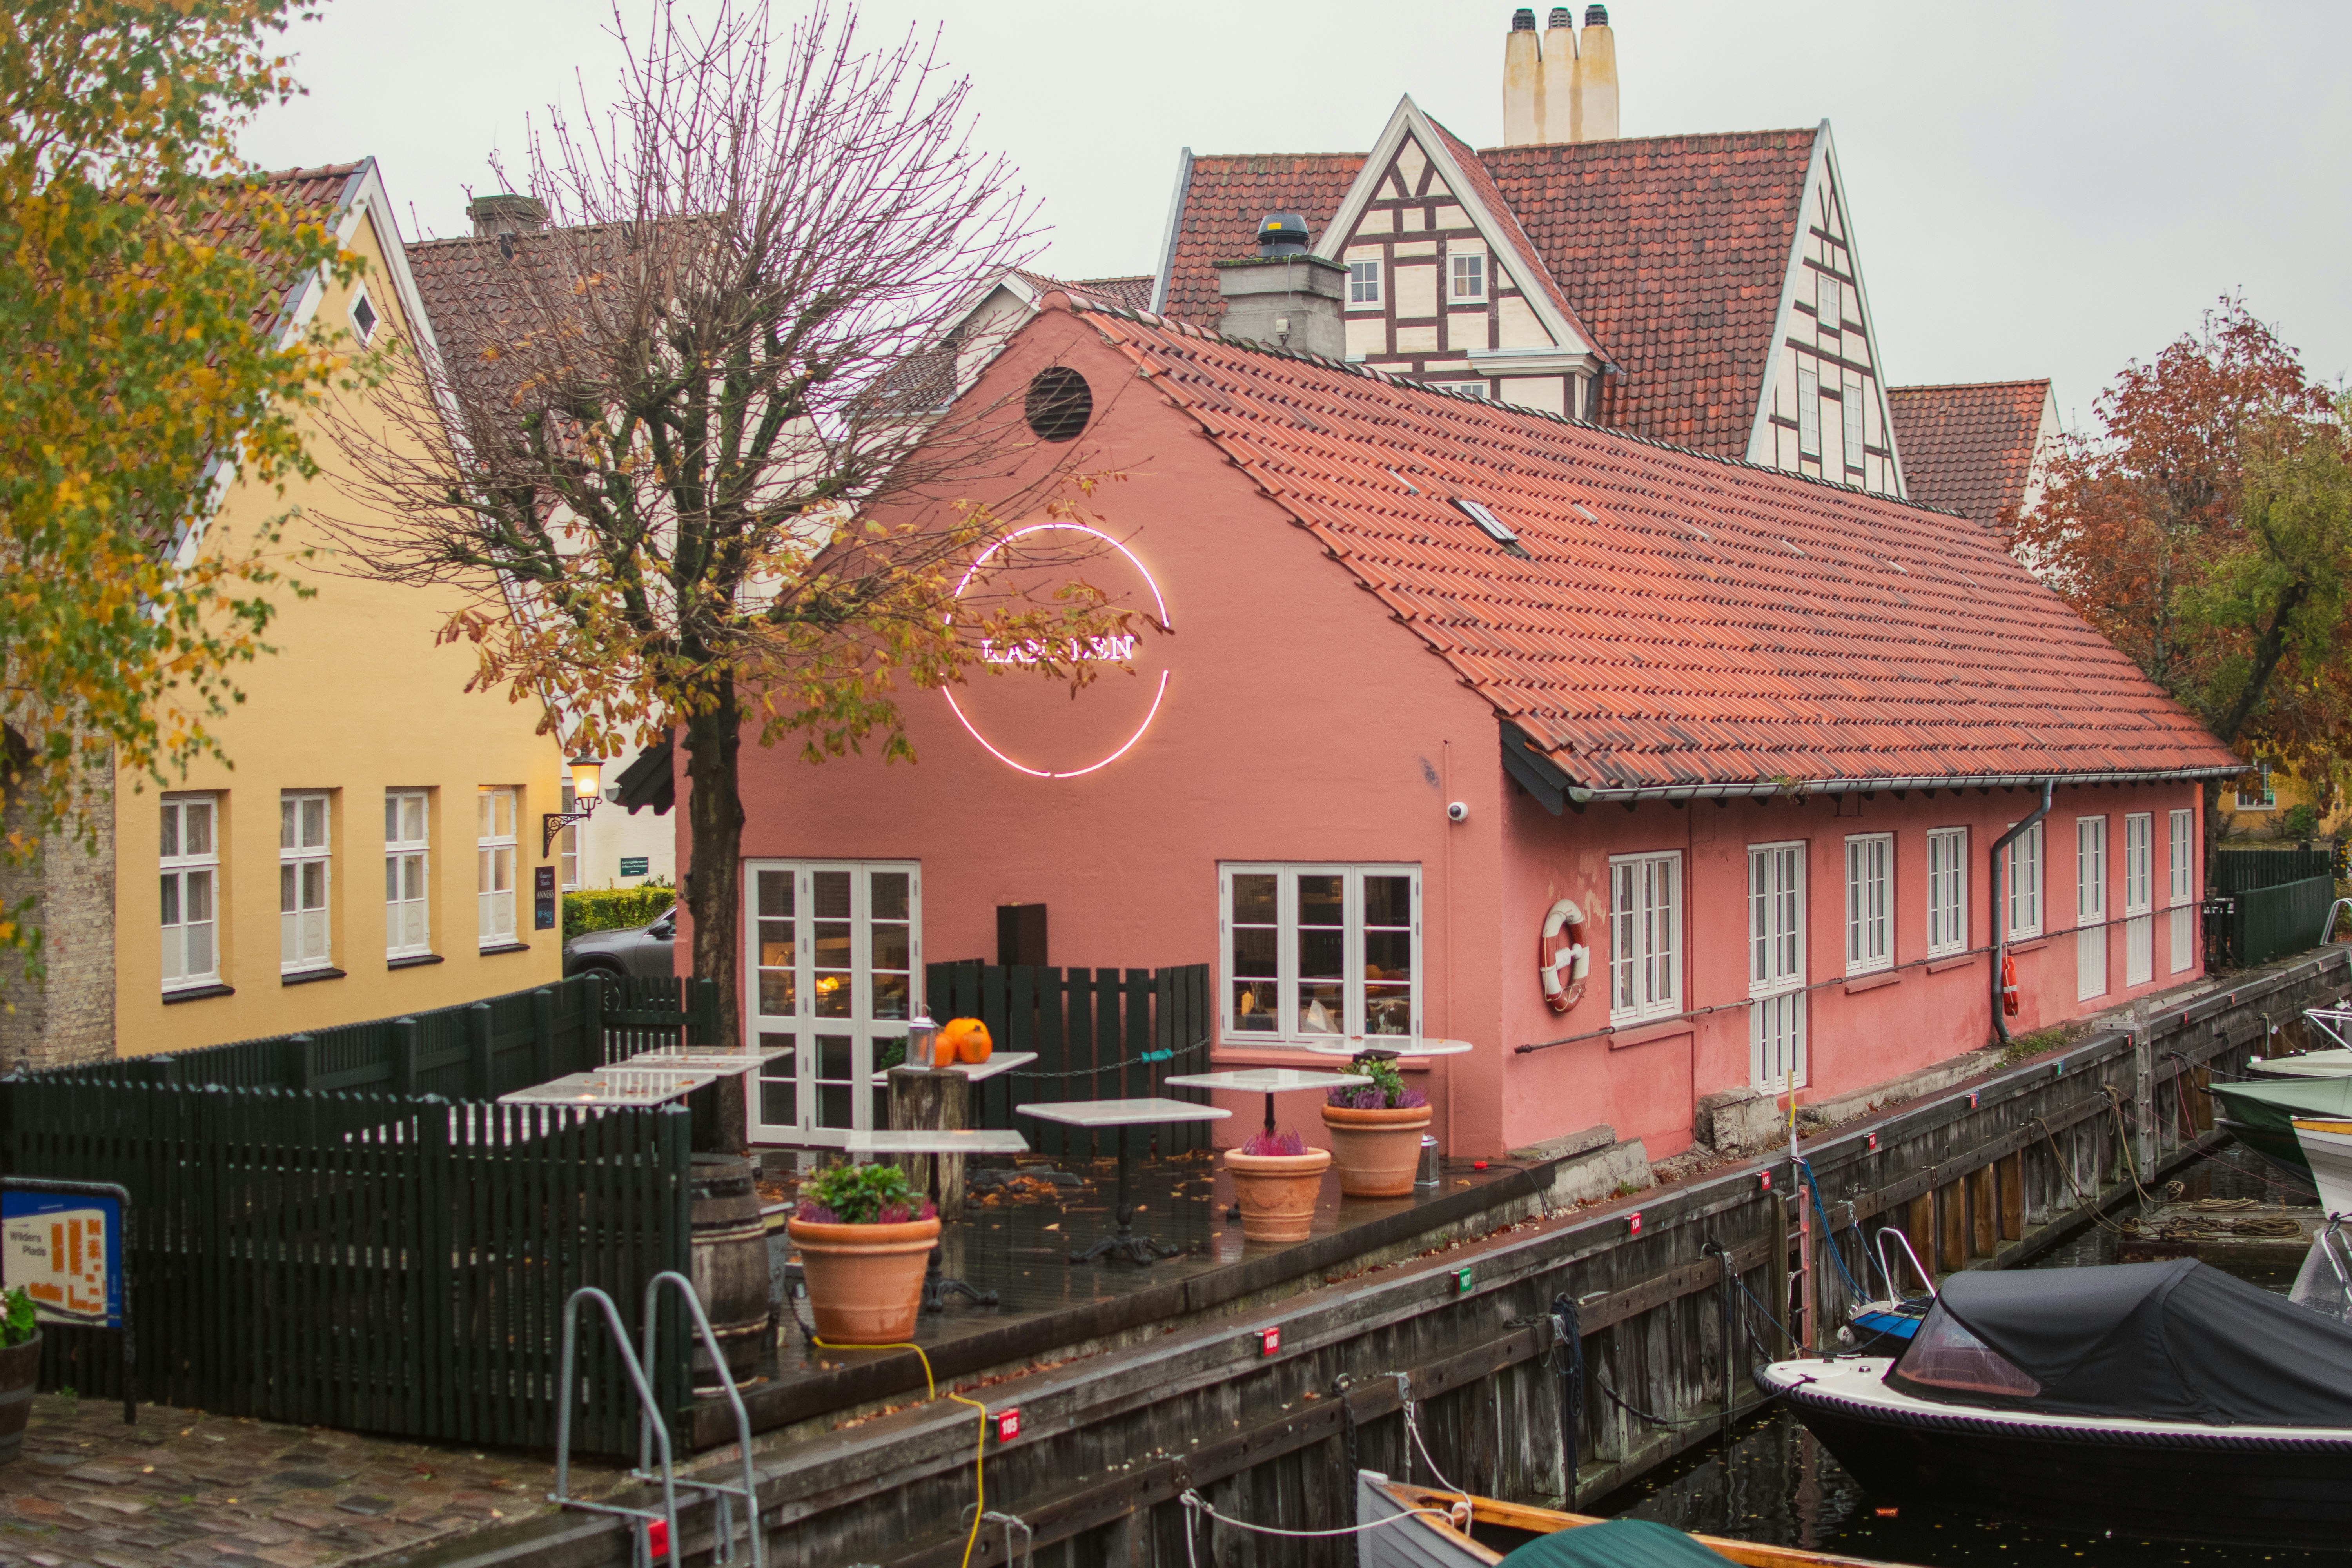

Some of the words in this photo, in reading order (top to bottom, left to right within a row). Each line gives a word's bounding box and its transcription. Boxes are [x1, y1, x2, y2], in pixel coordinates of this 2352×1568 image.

[981, 635, 1134, 663] KANLEN
[10, 1231, 42, 1243] Wilders
[22, 1245, 47, 1256] Plads
[1461, 1274, 1470, 1287] 107
[1002, 1417, 1018, 1436] 105
